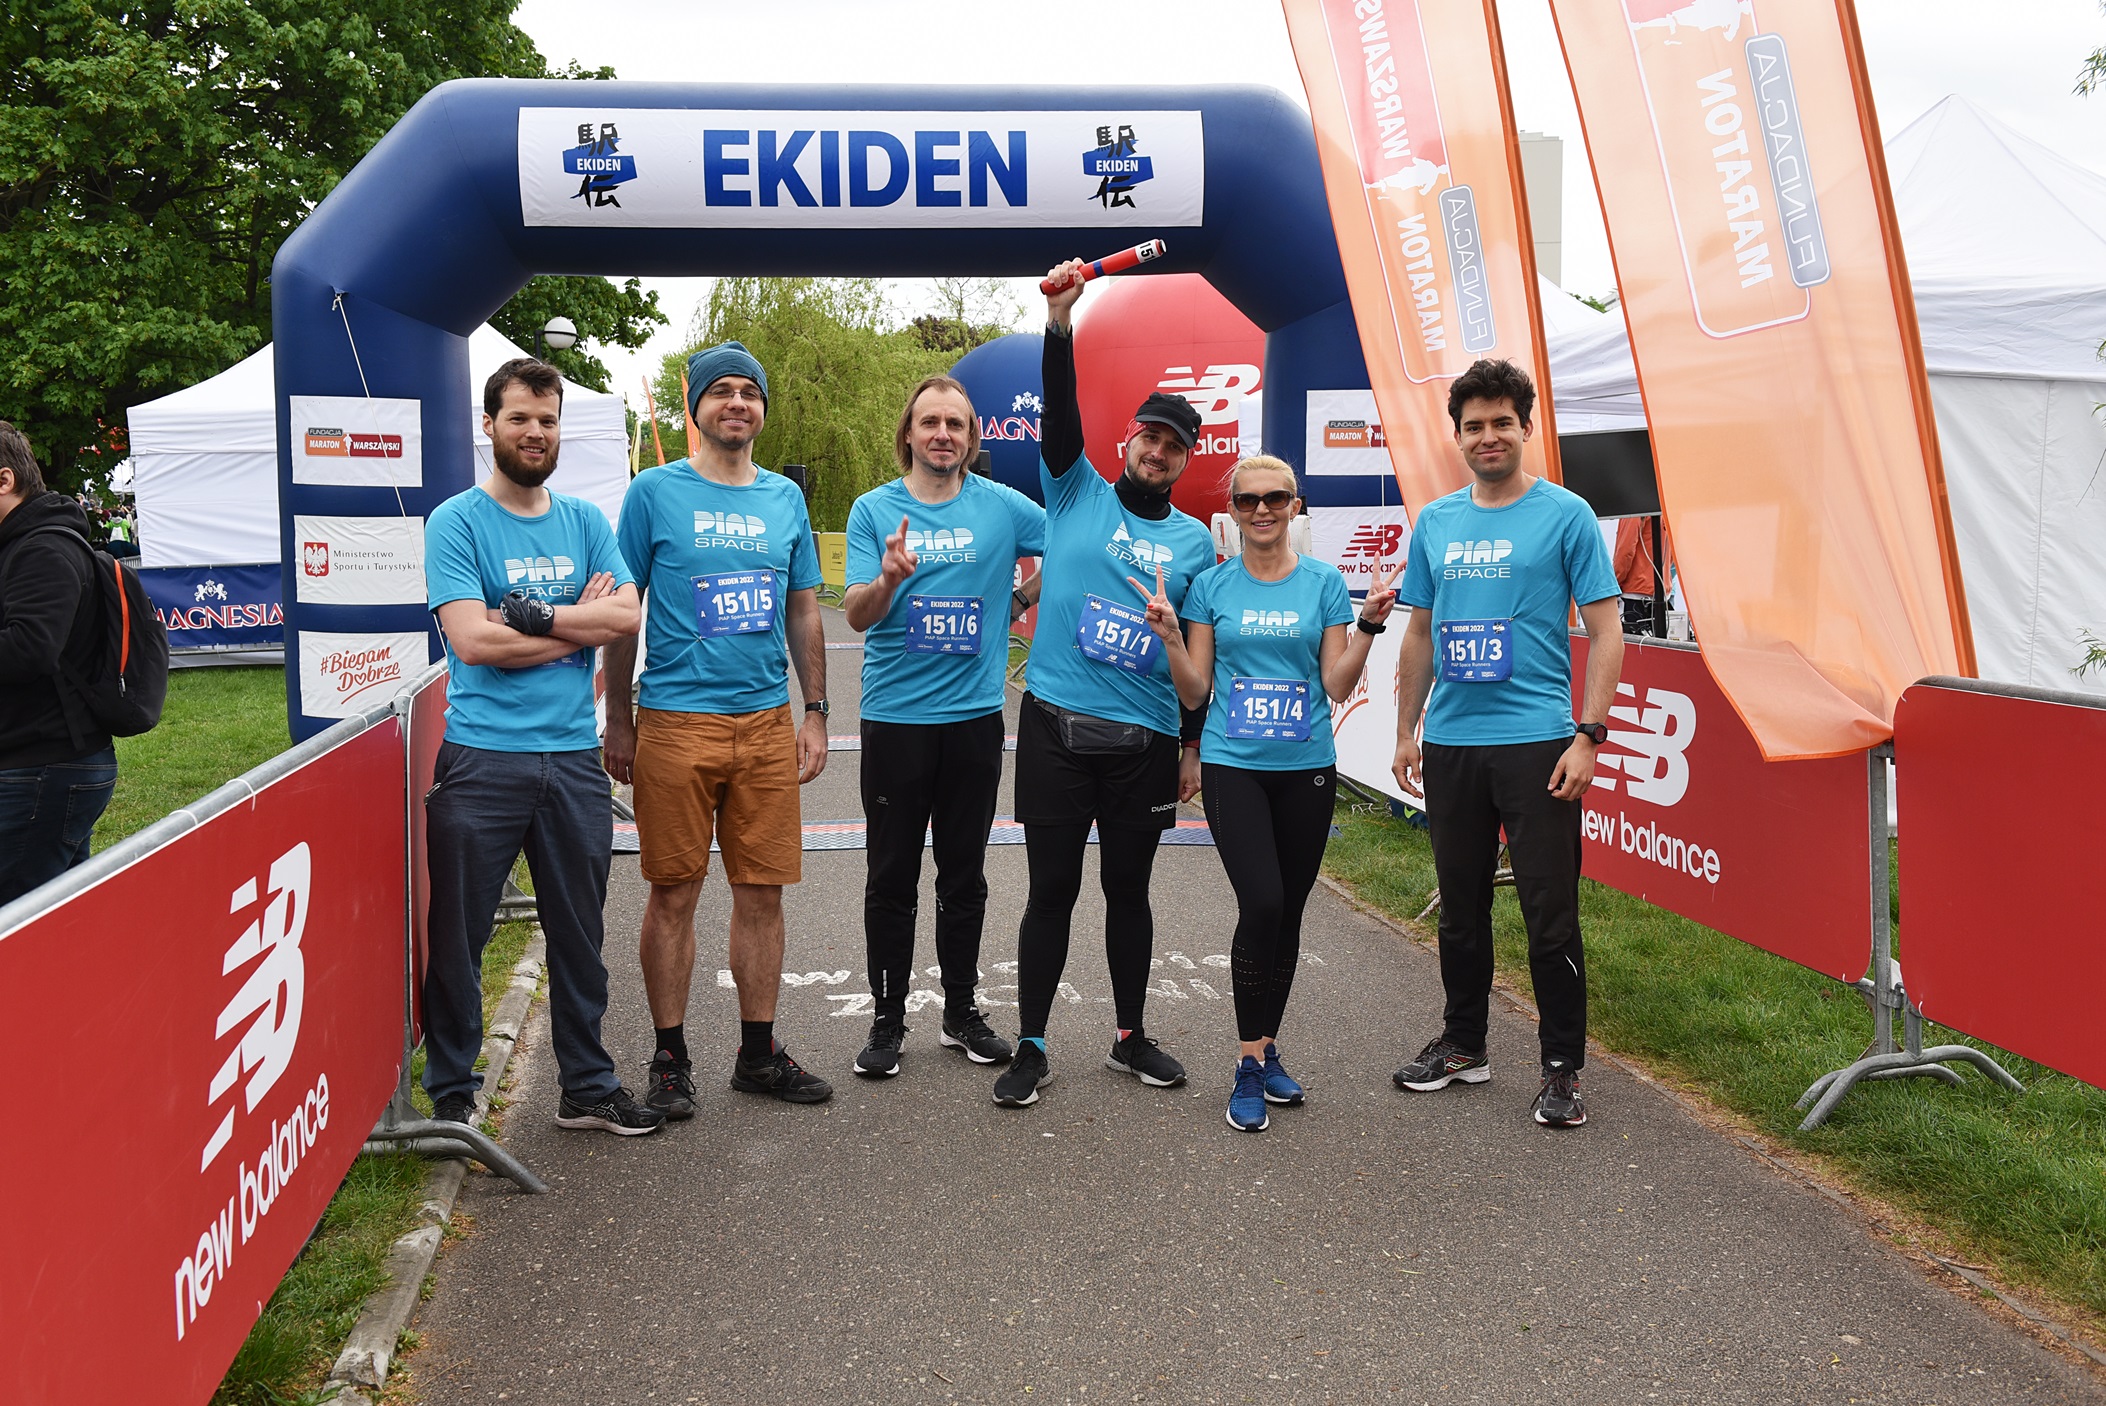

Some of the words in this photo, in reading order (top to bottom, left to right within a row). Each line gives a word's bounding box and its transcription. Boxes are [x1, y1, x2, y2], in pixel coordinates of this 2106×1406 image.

[576, 158, 622, 172] EKIDEN
[703, 130, 1028, 208] EKIDEN
[1096, 160, 1139, 172] EKIDEN
[310, 428, 342, 436] FUNDACJA
[1329, 432, 1362, 440] MARATON
[309, 439, 340, 449] MARATON
[352, 441, 400, 451] WARSZAWSKI
[694, 510, 766, 538] PIAP
[694, 537, 768, 554] SPACE
[905, 528, 974, 550] PIAP
[333, 550, 394, 558] Ministerstwo
[916, 552, 976, 564] PACE
[1444, 540, 1513, 564] PIAP
[333, 562, 364, 572] Sportu
[374, 562, 416, 572] Turystyki
[504, 555, 575, 584] PIAP
[1336, 564, 1356, 574] ew
[1444, 568, 1511, 580] SPACE
[712, 588, 772, 616] 151/5
[922, 614, 978, 636] 151/6
[1109, 607, 1130, 620] EKIDEN
[1130, 614, 1145, 626] 2022
[1242, 609, 1300, 626] PIAP
[1096, 618, 1152, 656] 151/1
[1240, 628, 1300, 638] SPACE
[1447, 638, 1503, 661] 151/3
[320, 646, 392, 676] #Biegam
[1243, 697, 1303, 720] 151/4
[1620, 810, 1720, 884] balance
[174, 1195, 235, 1342] new
[239, 1072, 330, 1246] balance
